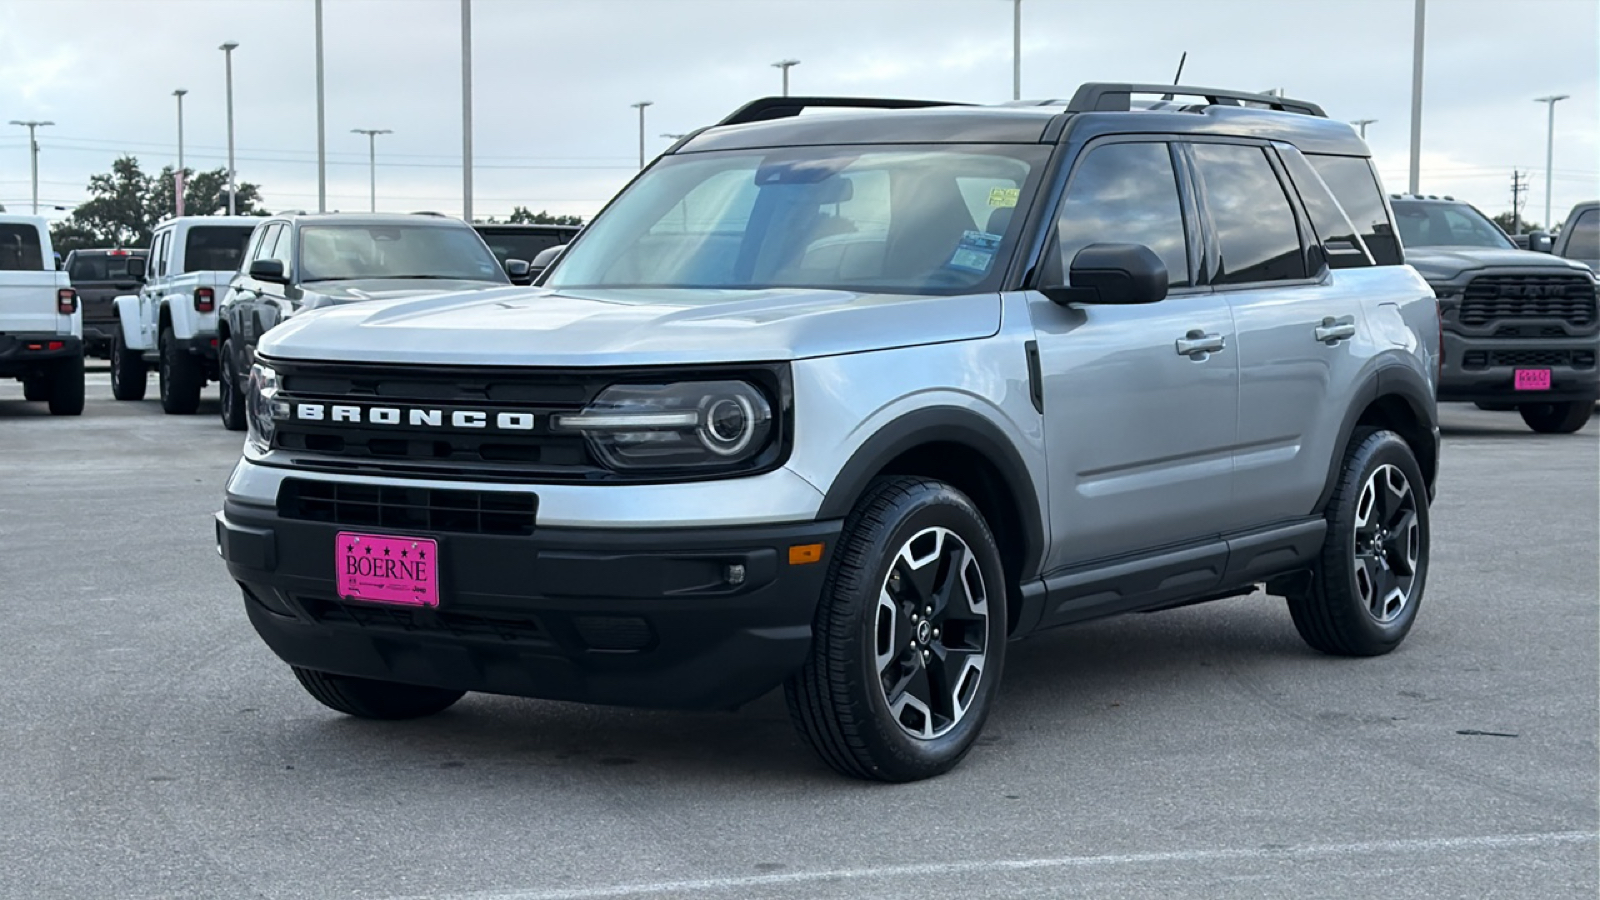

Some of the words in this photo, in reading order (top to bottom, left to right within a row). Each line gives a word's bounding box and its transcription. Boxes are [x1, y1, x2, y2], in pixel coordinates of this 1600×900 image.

[1500, 284, 1566, 297] RAM
[297, 403, 535, 430] BRONCO
[346, 555, 427, 582] BOERNE
